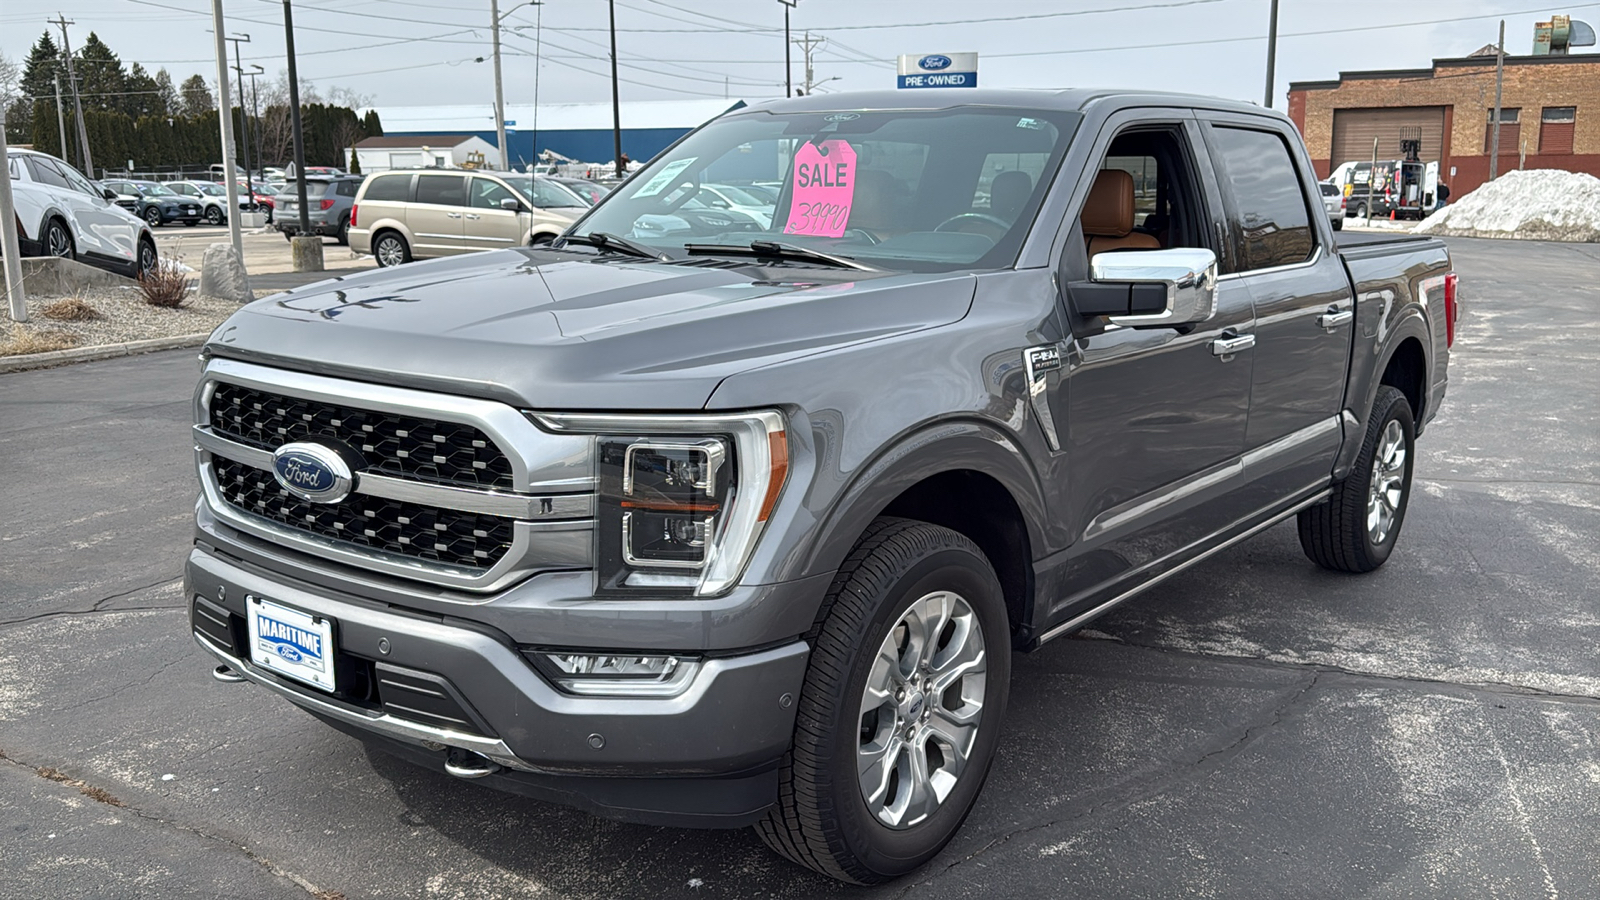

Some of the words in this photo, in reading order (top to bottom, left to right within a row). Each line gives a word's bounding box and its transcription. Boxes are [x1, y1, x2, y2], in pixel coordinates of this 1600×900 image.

[924, 57, 943, 68] Ford
[905, 74, 965, 87] PRE-OWNED
[798, 163, 848, 188] SALE
[284, 457, 321, 487] Ford
[258, 616, 321, 658] MARITIME
[280, 646, 299, 661] Ford
